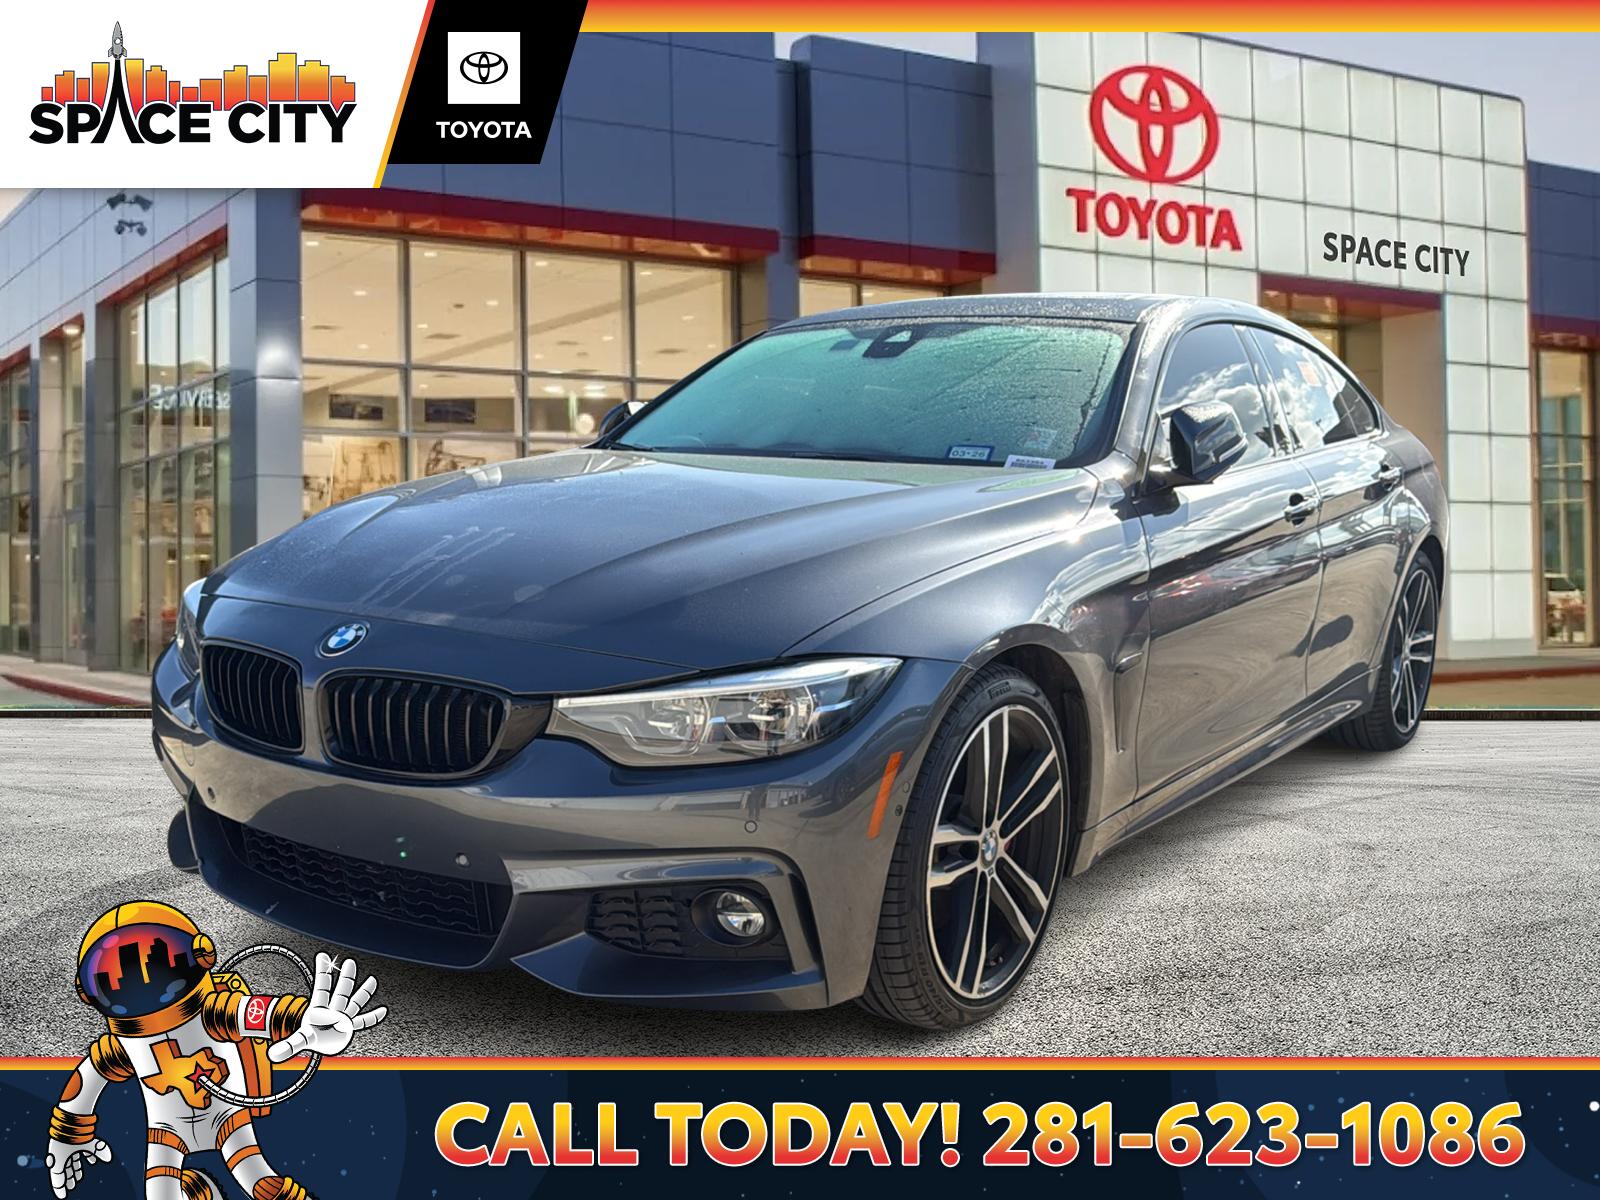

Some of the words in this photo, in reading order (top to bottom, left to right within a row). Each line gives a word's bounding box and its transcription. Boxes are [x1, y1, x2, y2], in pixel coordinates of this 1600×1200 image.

[1066, 188, 1243, 252] TOYOTA
[1323, 232, 1408, 271] SPACE
[1414, 244, 1471, 277] CITY
